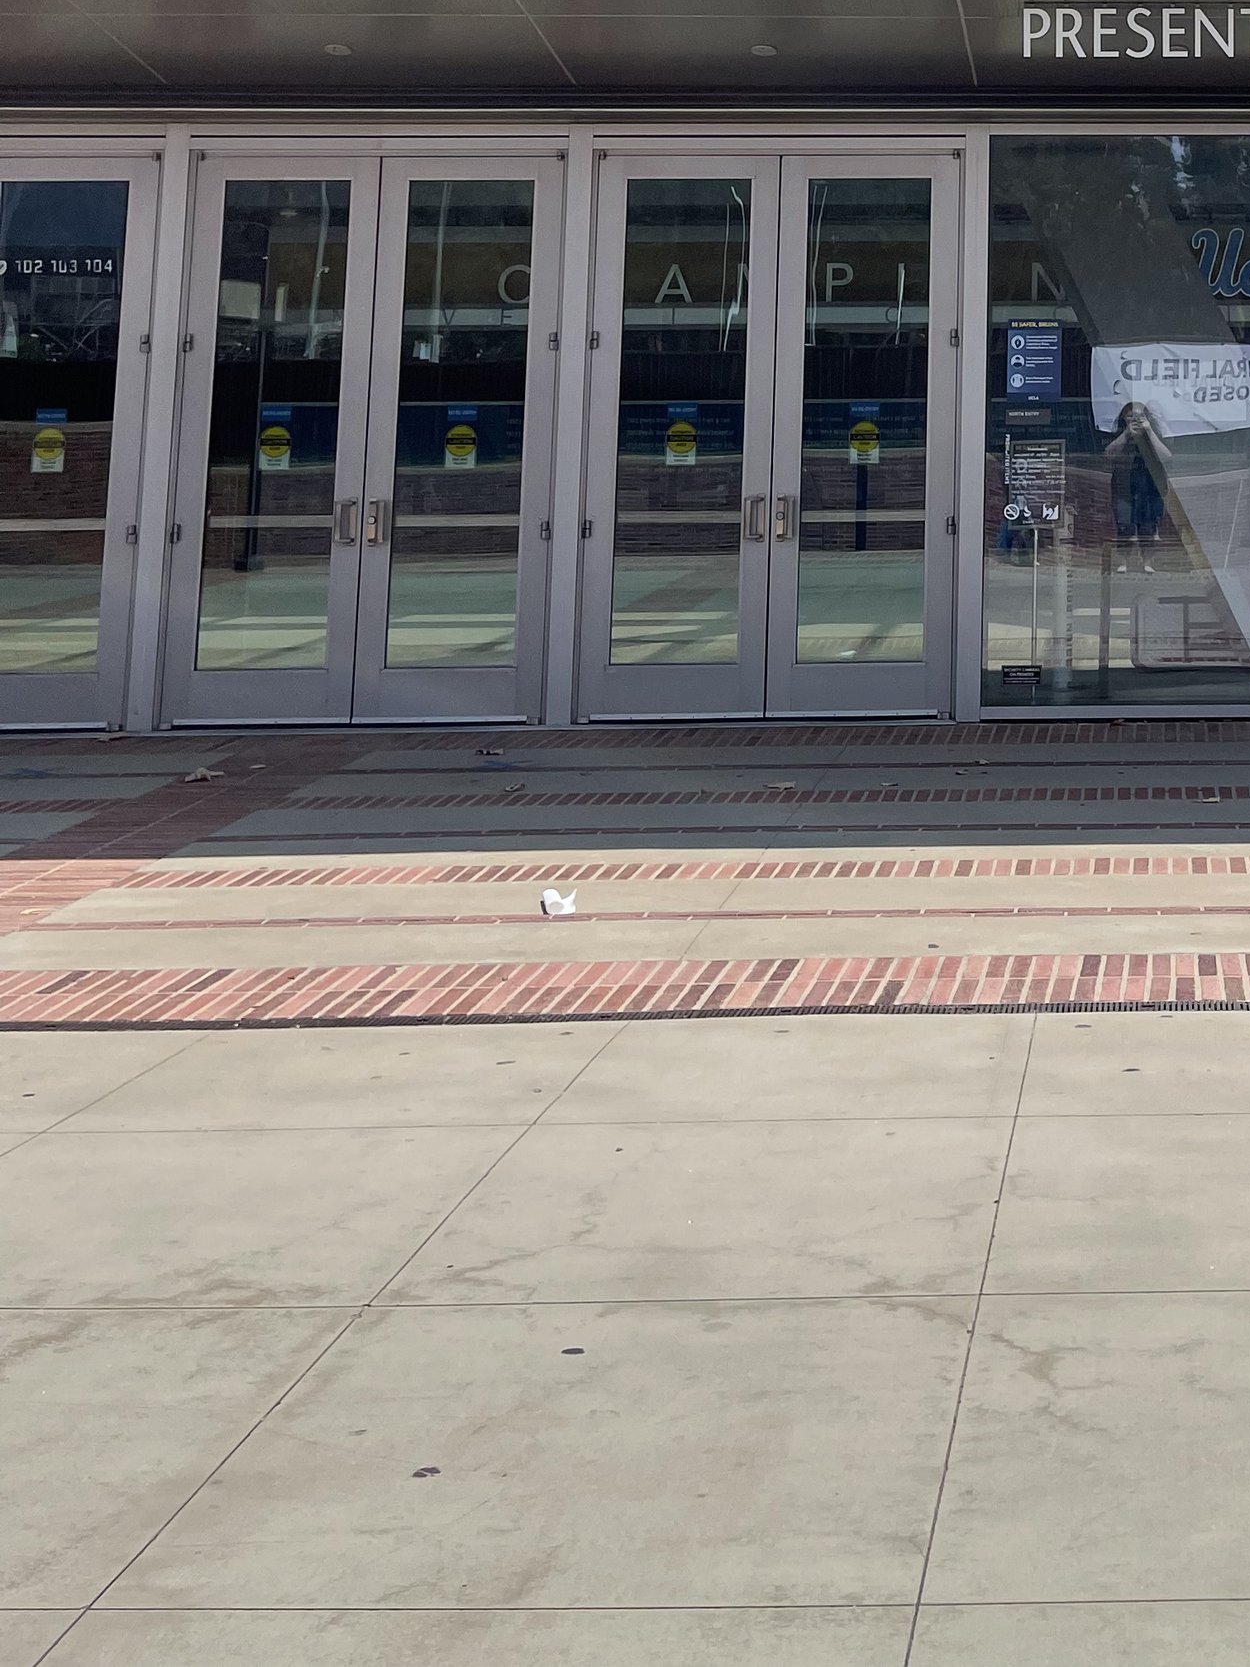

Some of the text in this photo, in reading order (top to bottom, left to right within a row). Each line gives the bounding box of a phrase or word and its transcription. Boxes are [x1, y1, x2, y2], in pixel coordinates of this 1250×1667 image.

[15, 259, 113, 274] 102 103 104
